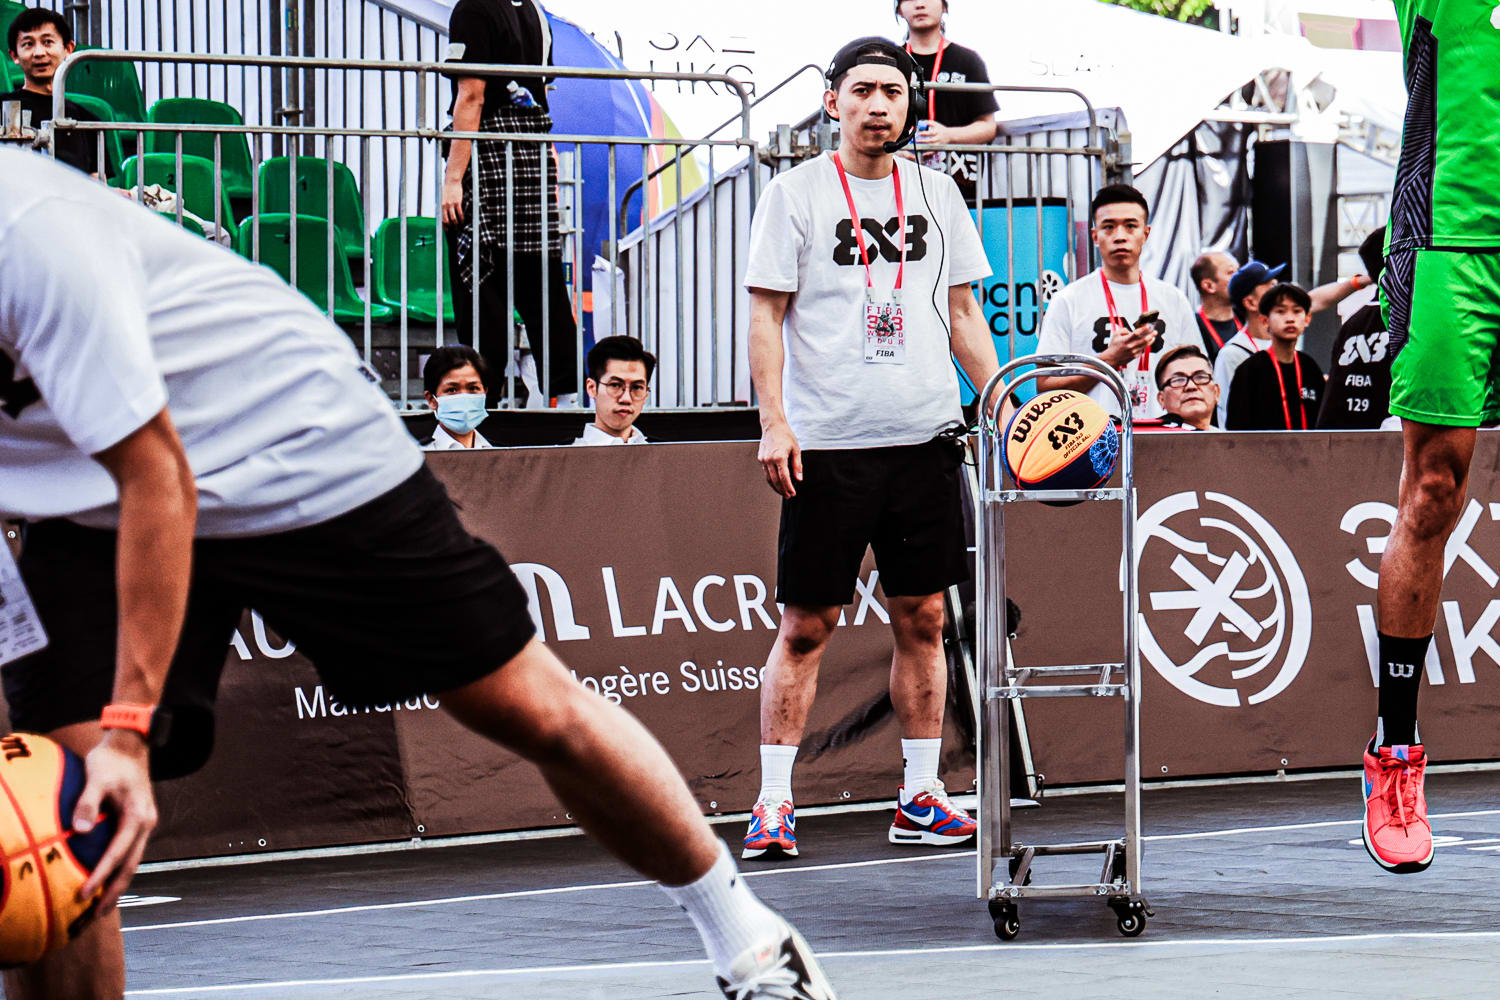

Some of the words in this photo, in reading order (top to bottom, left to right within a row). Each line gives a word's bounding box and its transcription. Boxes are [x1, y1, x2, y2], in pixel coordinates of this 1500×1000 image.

[875, 350, 895, 358] FIBA
[1345, 374, 1372, 387] FIBA
[1346, 398, 1370, 412] 129
[1011, 392, 1076, 443] Wilson
[602, 566, 891, 638] LACRX
